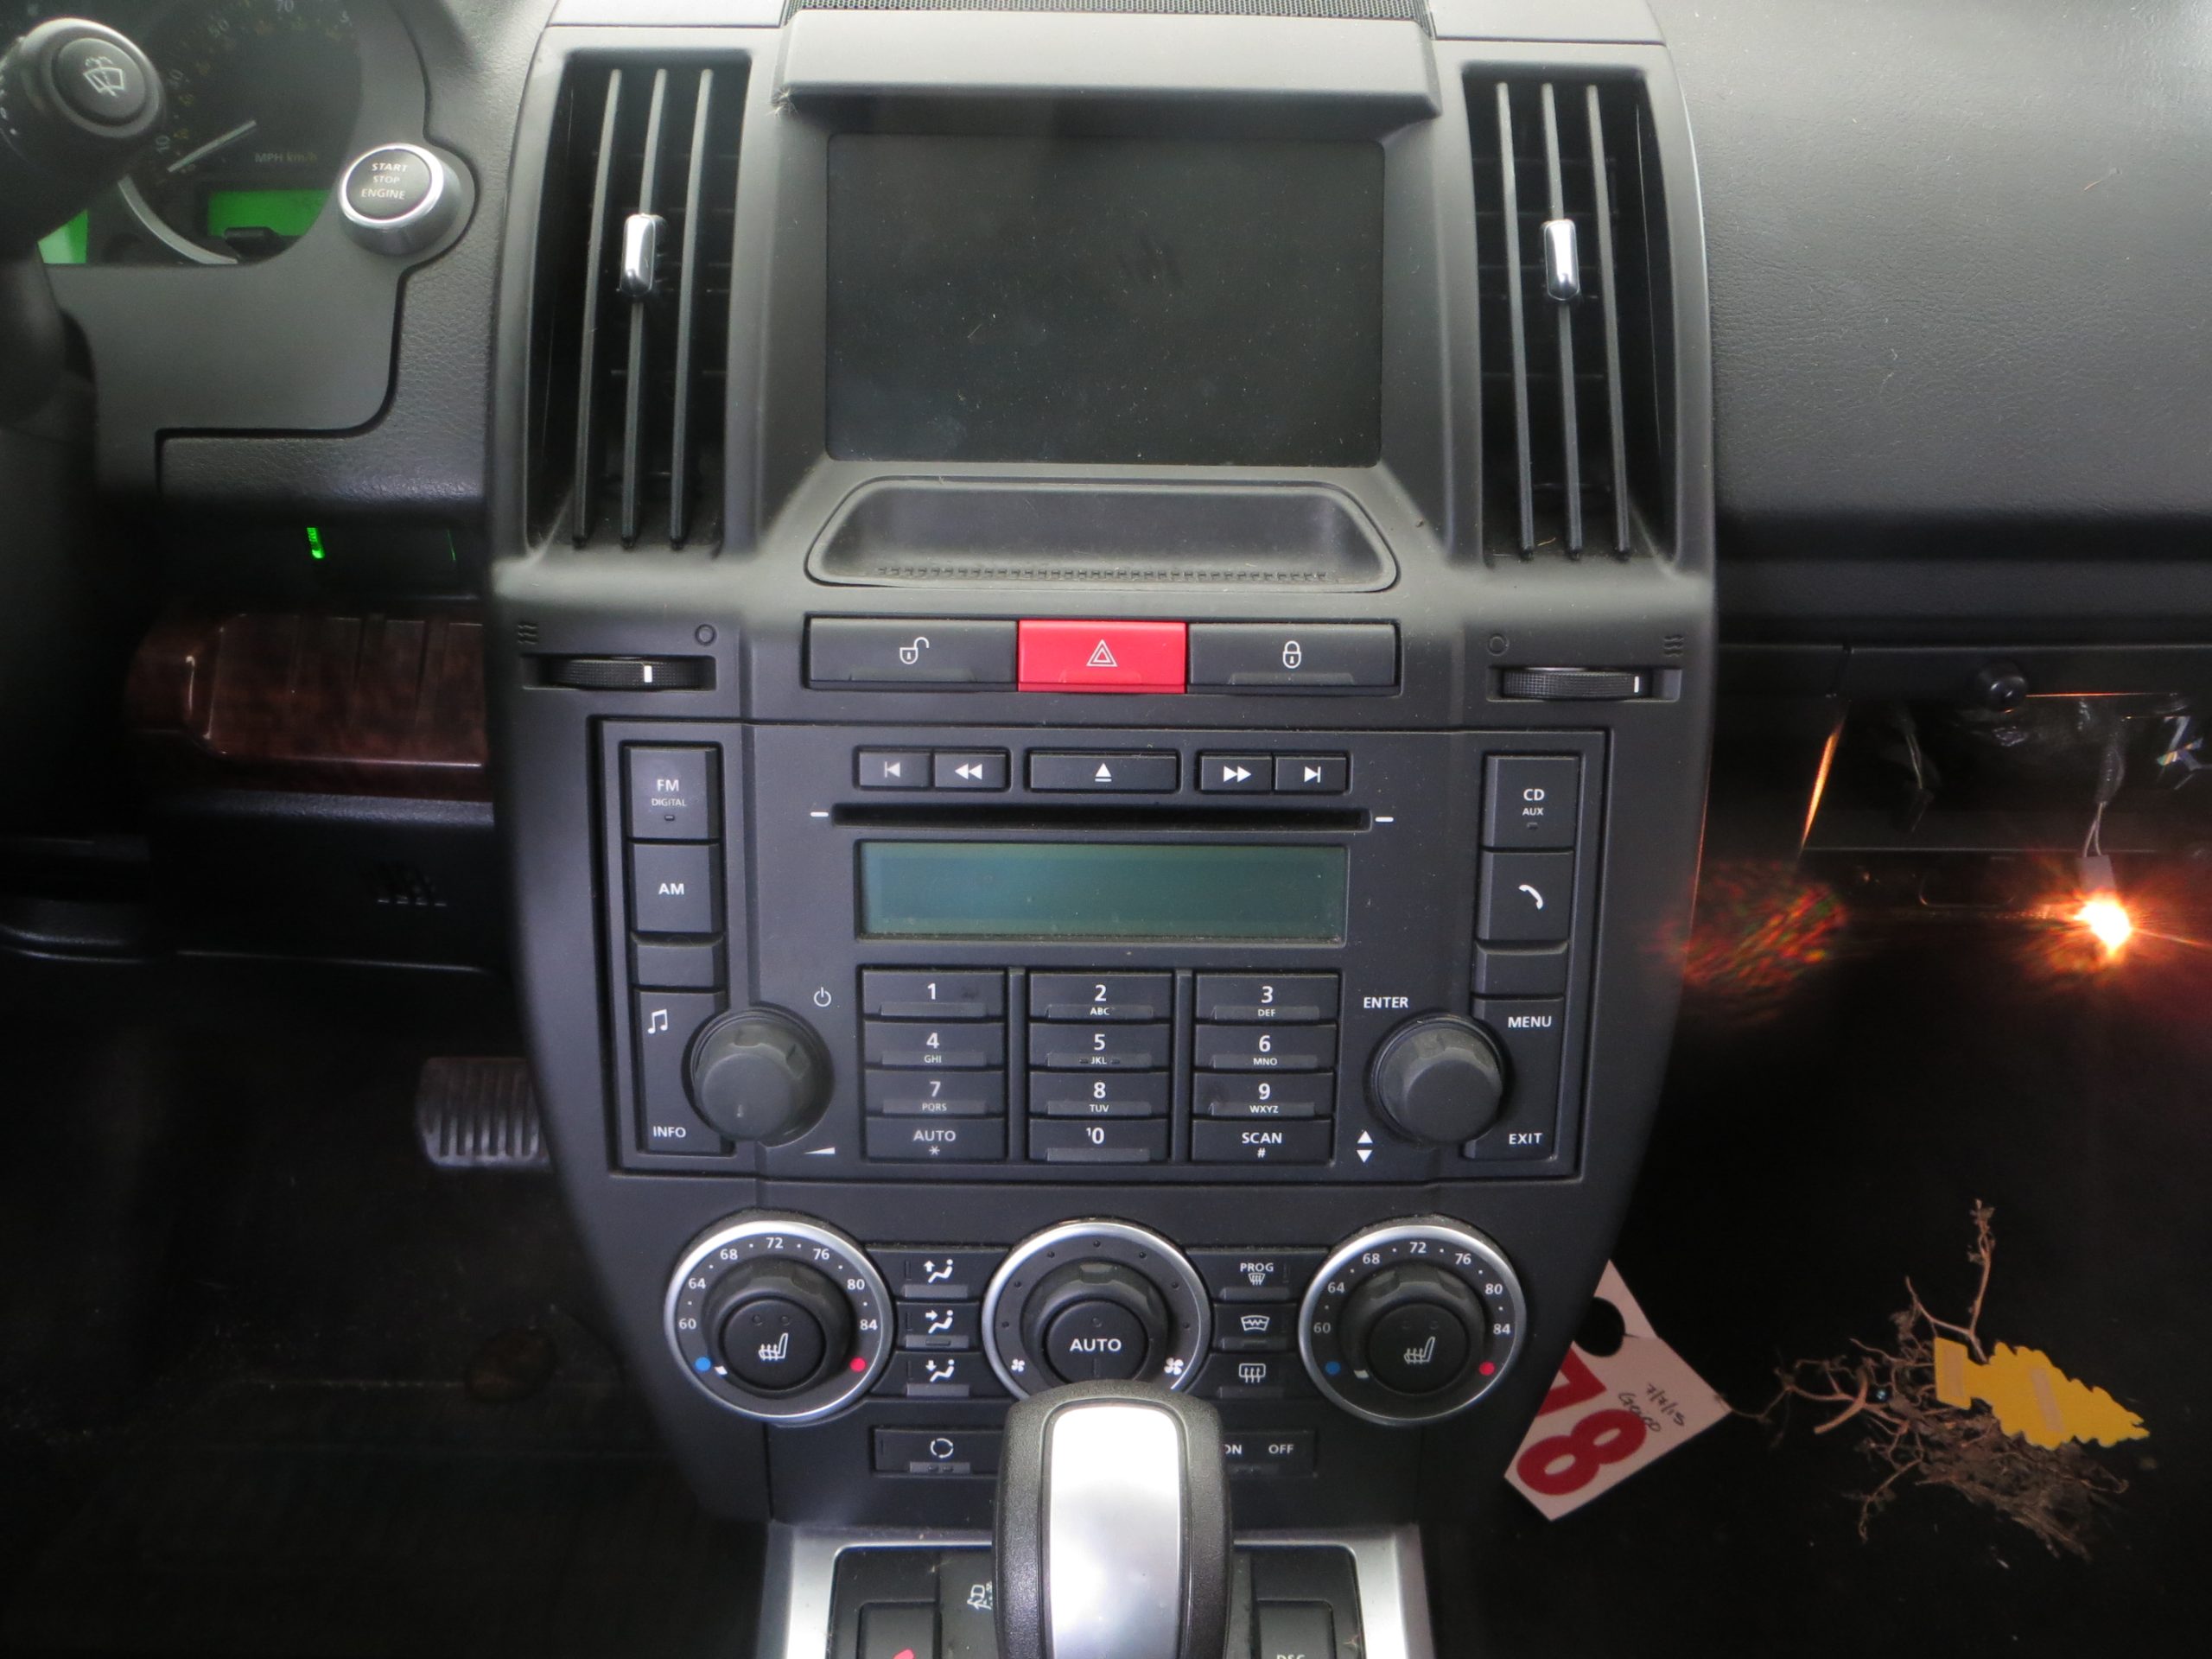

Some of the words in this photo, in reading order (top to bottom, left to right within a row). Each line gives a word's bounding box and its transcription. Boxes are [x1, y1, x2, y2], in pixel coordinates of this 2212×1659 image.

[255, 152, 283, 162] MPH
[371, 162, 409, 173] START
[372, 174, 401, 184] STOP
[360, 188, 406, 200] ENGINE
[657, 779, 679, 791] FM
[1522, 788, 1545, 802] CD
[651, 798, 685, 807] DIGITAL
[1522, 807, 1544, 817] AUX
[658, 882, 685, 895] AM
[927, 982, 936, 1000] 1
[1094, 984, 1107, 1002] 2
[1261, 985, 1274, 1004] 3
[1363, 996, 1408, 1009] ENTER
[1090, 1007, 1109, 1016] ABC
[1257, 1008, 1276, 1017] DEF
[1508, 1015, 1552, 1028] MENU
[925, 1032, 940, 1049] 4
[1094, 1033, 1106, 1051] 5
[1258, 1034, 1271, 1052] 6
[924, 1054, 942, 1064] GHI
[1090, 1056, 1108, 1065] JKL
[1253, 1057, 1278, 1066] MNO
[930, 1080, 941, 1097] 7
[1093, 1081, 1106, 1099] 8
[1258, 1083, 1271, 1101] 9
[921, 1103, 948, 1113] PQRS
[1089, 1103, 1109, 1113] TUV
[1249, 1104, 1279, 1114] WXYZ
[652, 1126, 687, 1138] INFO
[912, 1129, 957, 1142] AUTO
[1242, 1132, 1282, 1144] SCAN
[1509, 1132, 1542, 1145] EXIT
[766, 1236, 784, 1249] 72
[1409, 1241, 1427, 1254] 72
[720, 1248, 738, 1261] 68
[812, 1248, 830, 1261] 76
[1362, 1252, 1381, 1265] 68
[1455, 1253, 1471, 1265] 76
[1240, 1262, 1274, 1273] PROG
[688, 1277, 707, 1290] 64
[847, 1278, 866, 1291] 80
[1327, 1281, 1345, 1294] 64
[1484, 1283, 1503, 1295] 80
[678, 1318, 697, 1330] 60
[860, 1319, 878, 1331] 84
[1313, 1322, 1332, 1334] 60
[1493, 1323, 1511, 1335] 84
[1069, 1338, 1122, 1352] AUTO
[1268, 1444, 1294, 1454] OFF
